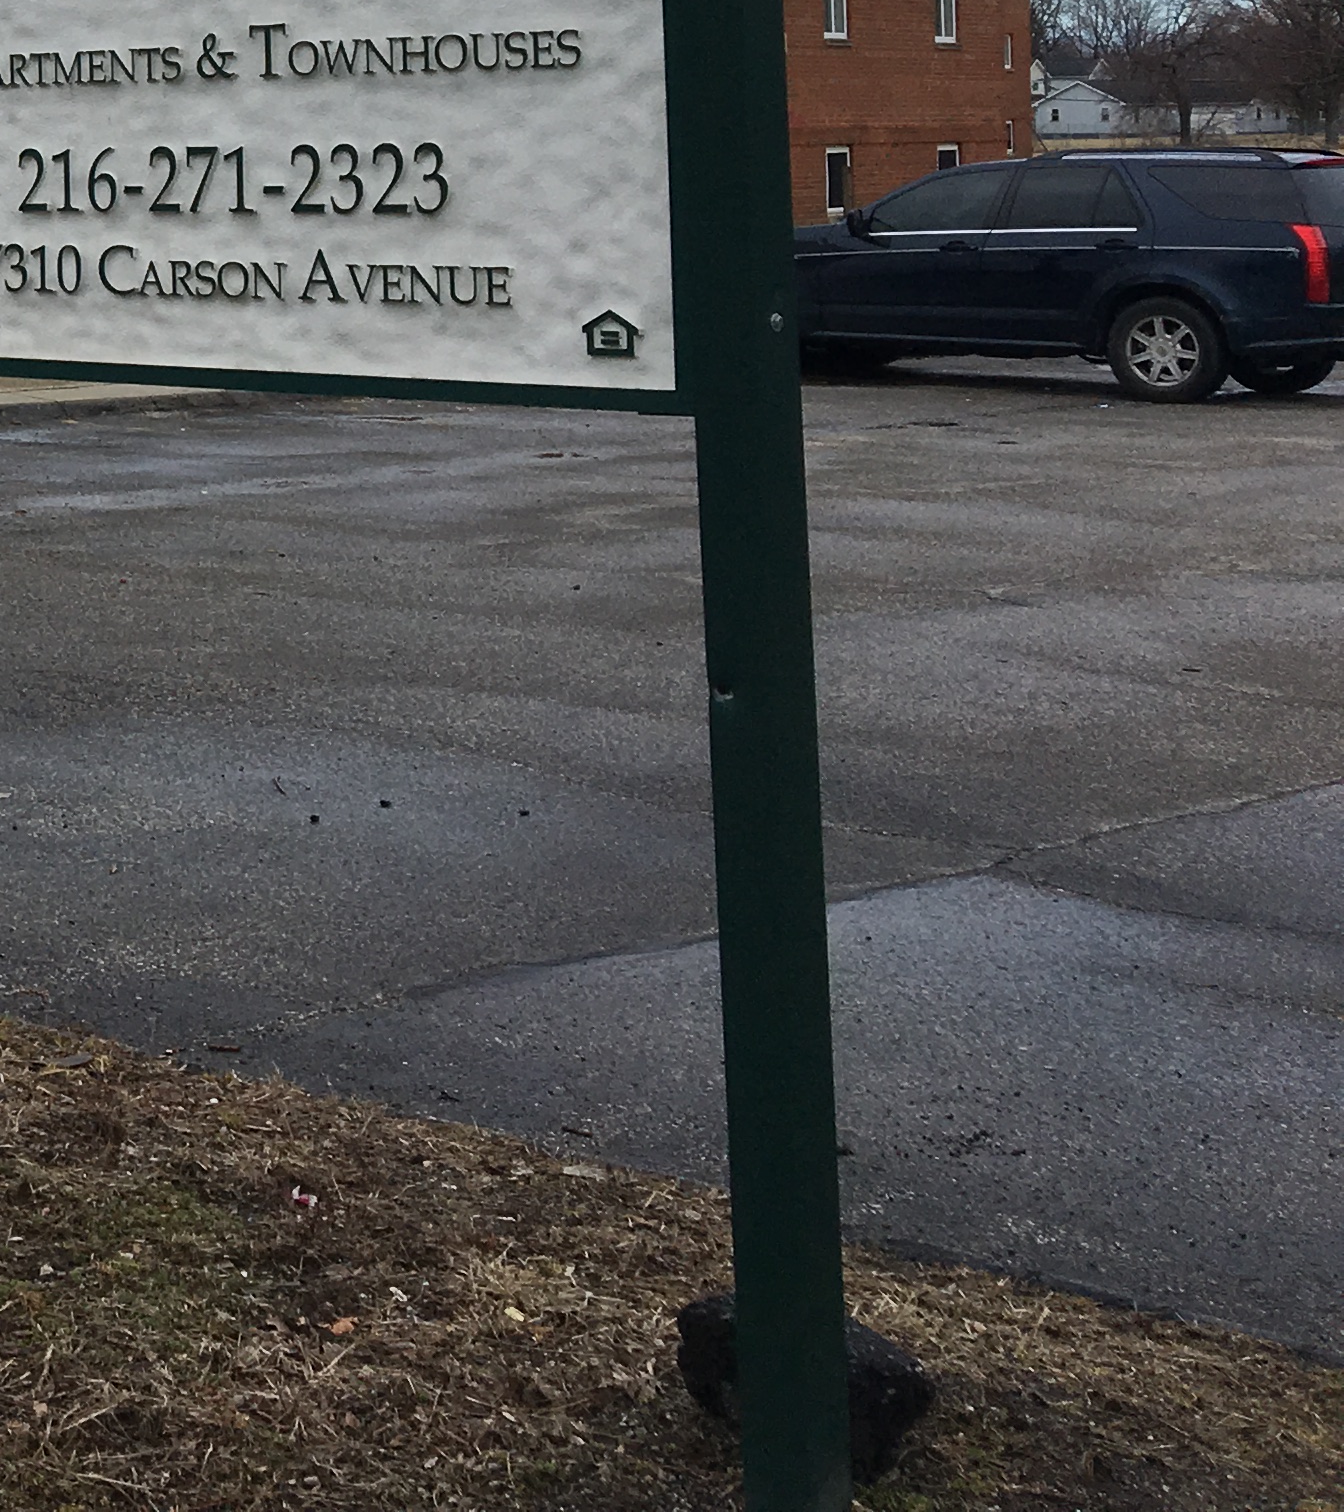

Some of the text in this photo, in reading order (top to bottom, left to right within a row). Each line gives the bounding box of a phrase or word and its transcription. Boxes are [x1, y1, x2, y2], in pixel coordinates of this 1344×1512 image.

[196, 32, 237, 80] &
[248, 22, 583, 81] TOWNHOUSES
[17, 142, 450, 215] 216-271-2323
[97, 244, 288, 303] CARSON
[298, 248, 514, 307] AVENUE
